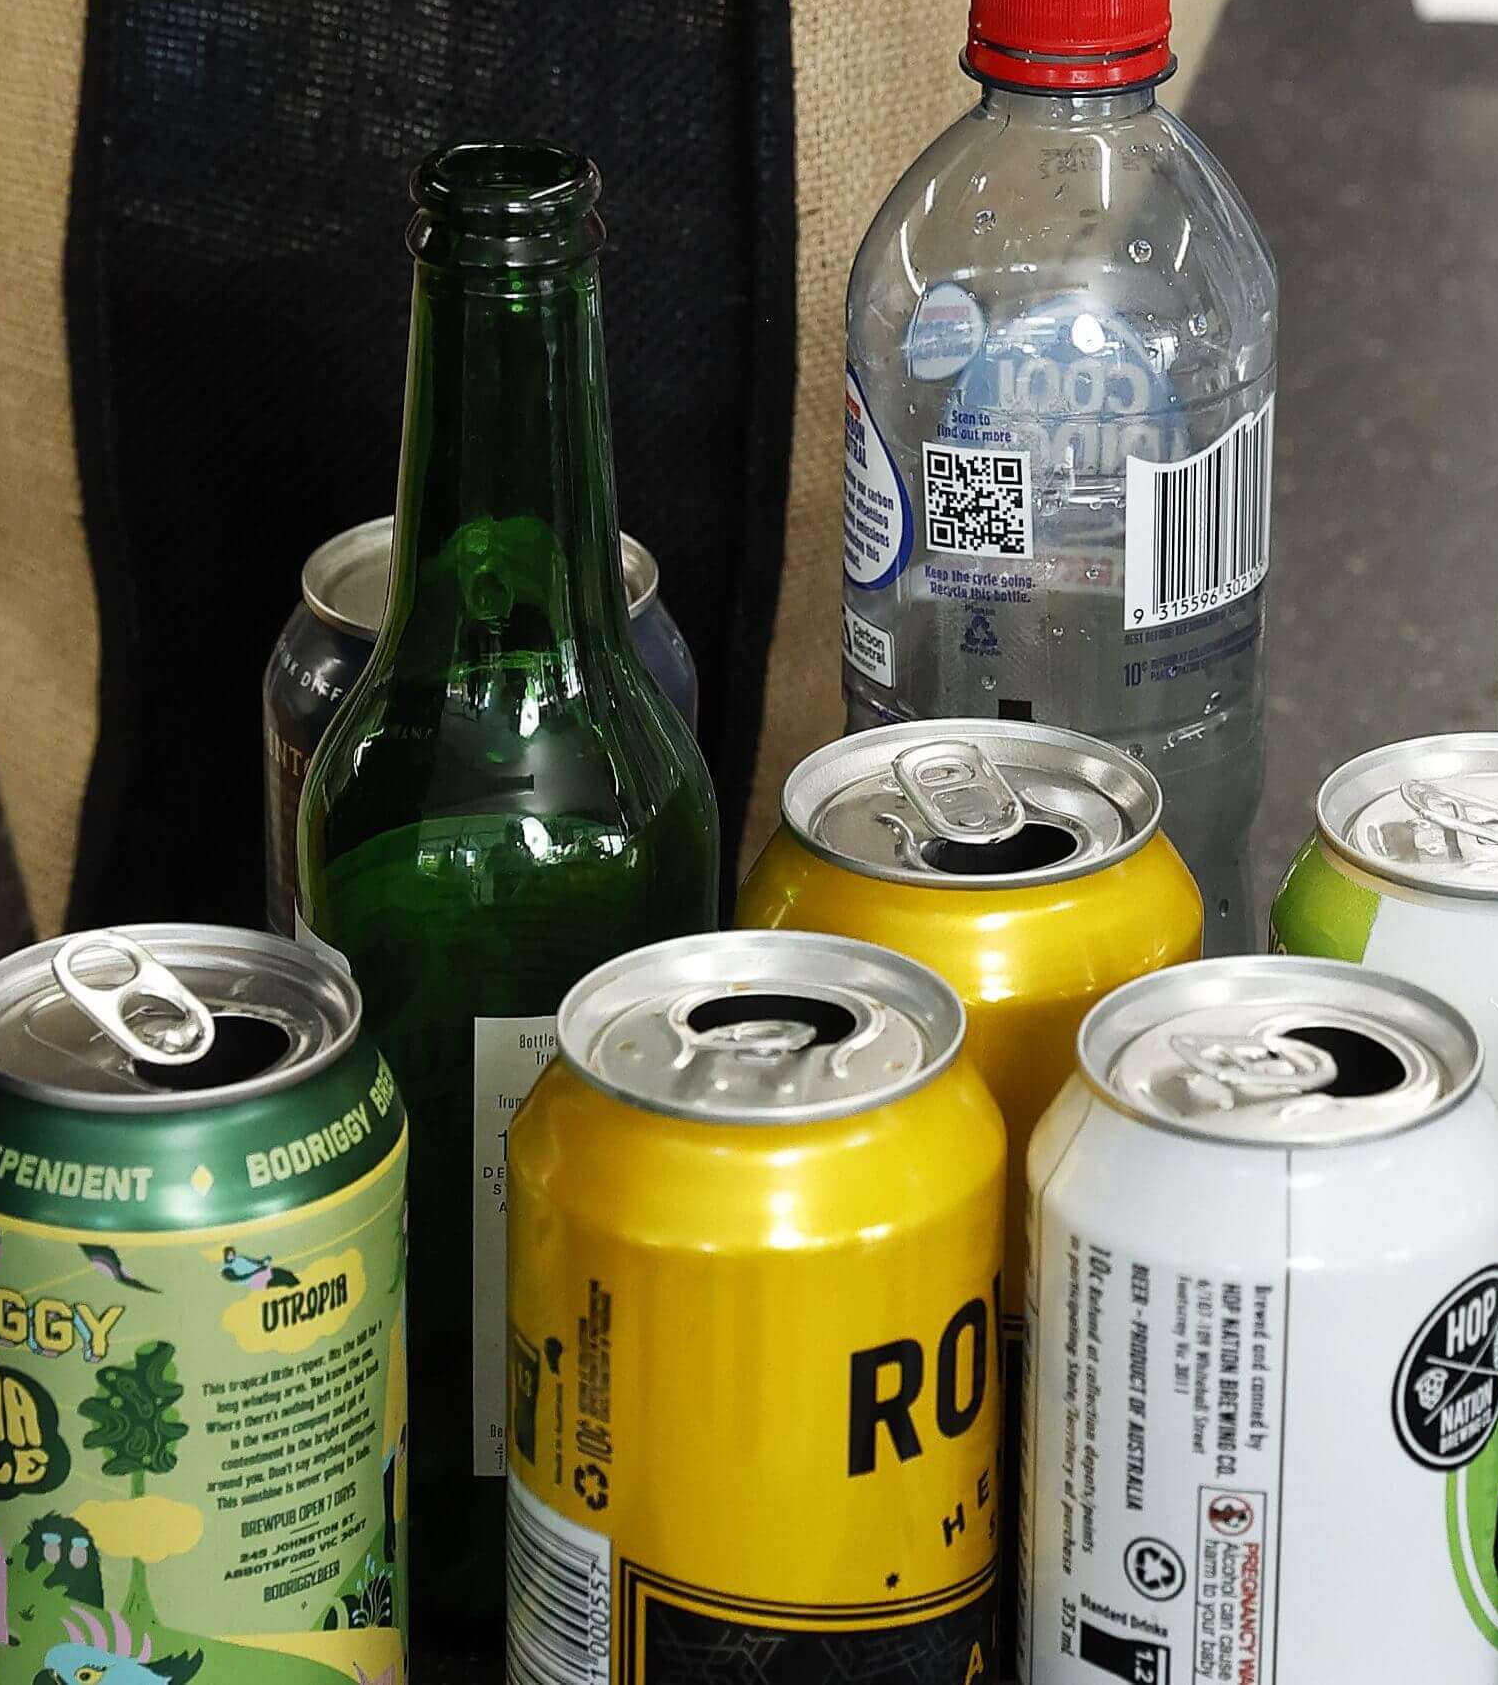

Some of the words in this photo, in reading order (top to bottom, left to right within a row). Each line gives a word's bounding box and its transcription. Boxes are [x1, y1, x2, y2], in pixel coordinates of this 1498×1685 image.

[951, 410, 975, 426] Scan
[979, 414, 990, 426] to
[960, 428, 980, 441] out
[982, 430, 1012, 443] more
[925, 565, 948, 582] Keep
[952, 569, 970, 583] the
[1133, 608, 1144, 625] 9
[1158, 590, 1218, 621] 315596
[245, 1100, 371, 1189] BODRIGGY
[262, 1272, 348, 1333] UTROPIA
[1131, 1264, 1151, 1306] BEER
[1221, 1284, 1241, 1313] HOP
[1445, 1286, 1496, 1358] HOP
[1128, 1320, 1149, 1396] PRODUCT
[1220, 1318, 1240, 1374] NATION
[848, 1271, 1002, 1477] RO
[1128, 1396, 1147, 1418] OF
[1217, 1379, 1238, 1451] BREWING
[1440, 1377, 1493, 1436] NATION
[1245, 1434, 1268, 1451] by
[1125, 1419, 1145, 1511] AUSTRALIA
[241, 1509, 297, 1538] BREWPUB
[299, 1497, 325, 1523] OPEN
[334, 1482, 356, 1508] DAYS
[224, 1548, 315, 1581] ABBOTSFORD
[319, 1535, 338, 1553] VIC
[272, 1521, 338, 1557] JOHNSTON
[1204, 1539, 1218, 1578] harm
[1203, 1584, 1217, 1598] to
[1221, 1542, 1240, 1598] Alcohol
[1195, 1602, 1216, 1636] your
[1219, 1603, 1234, 1630] can
[1239, 1542, 1260, 1654] PREGNANCY
[1134, 1649, 1155, 1684] 1.2
[1195, 1641, 1217, 1680] baby
[1218, 1634, 1232, 1681] cause
